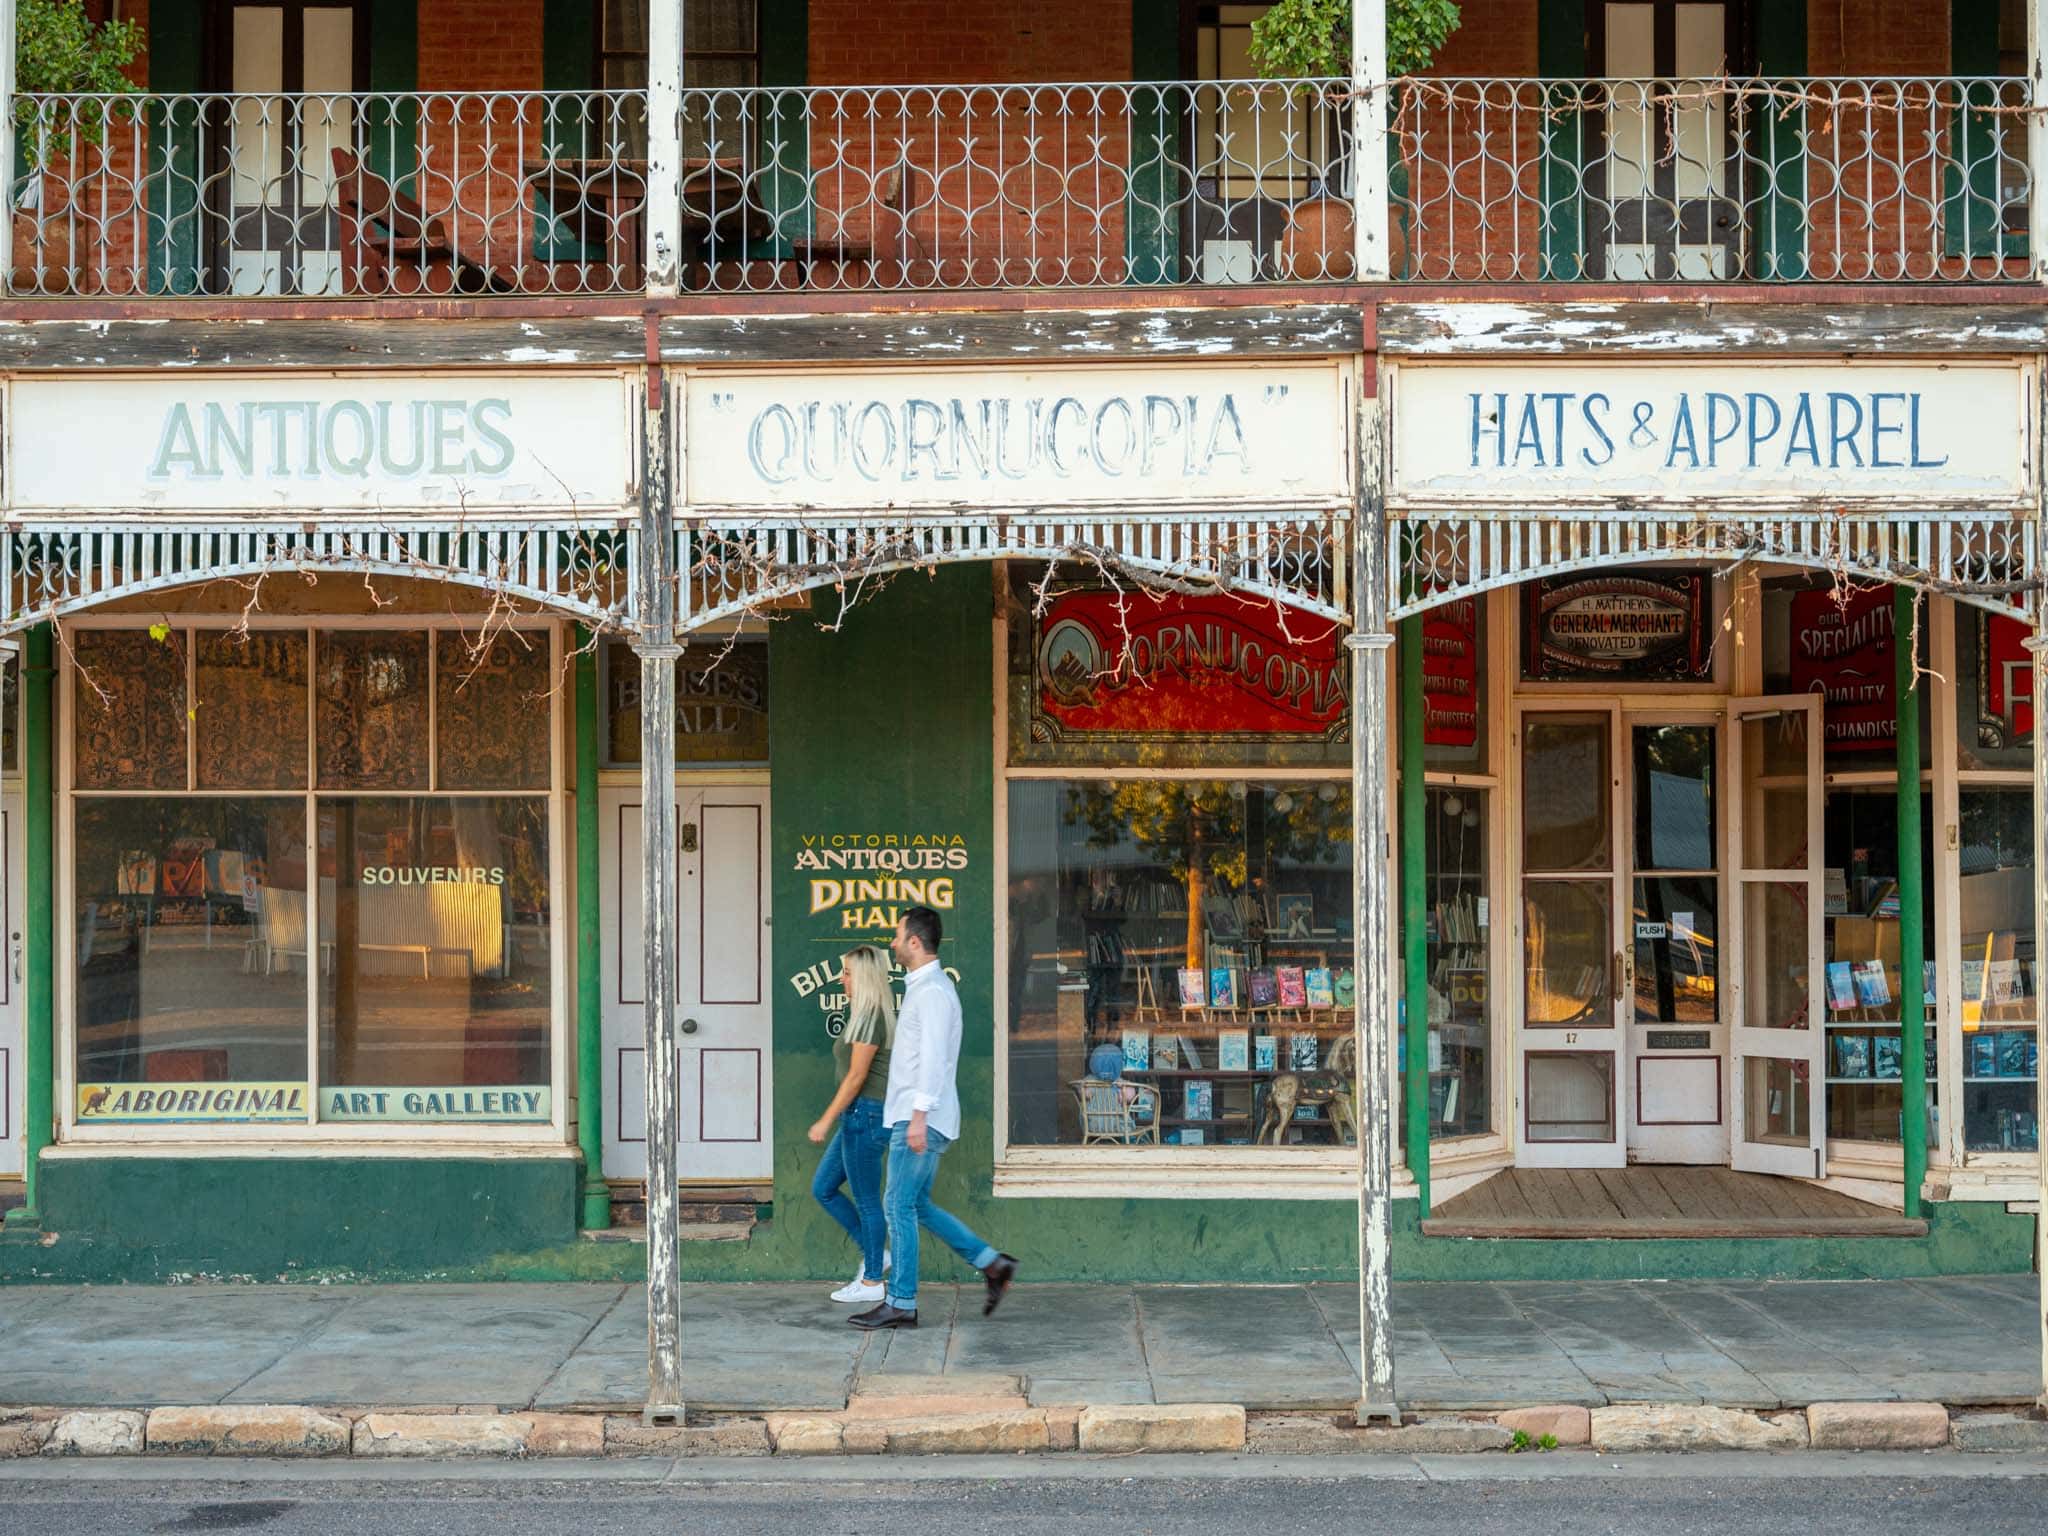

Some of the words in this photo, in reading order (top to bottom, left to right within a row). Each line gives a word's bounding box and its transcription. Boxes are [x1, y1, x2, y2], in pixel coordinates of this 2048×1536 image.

[147, 398, 515, 480] ANTIQUES
[1467, 392, 1614, 468] HATS
[1628, 401, 1658, 449] &
[1663, 392, 1949, 469] APPAREL
[1595, 599, 1651, 610] MATTHEWS
[1553, 613, 1607, 634] GENERAL
[1609, 613, 1682, 634] MERCHANT
[1800, 605, 1896, 656] SPECIALITY
[1818, 613, 1840, 625] OUR
[1567, 636, 1636, 649] RENOVATED
[1039, 618, 1352, 714] QUORNUCOPIA
[676, 705, 738, 734] ALL
[1779, 712, 1897, 744] MCHANDISE
[801, 834, 966, 847] VICTORIANA
[794, 848, 968, 872] ANTIQUES
[363, 866, 504, 885] SOUVENIRS
[809, 877, 954, 915] DINING
[841, 905, 899, 929] HAL
[1639, 926, 1664, 934] PUSH
[1565, 1033, 1578, 1044] 17
[111, 1088, 303, 1112] ABORIGINAL
[330, 1092, 391, 1114] ART
[403, 1092, 542, 1114] GALLERY
